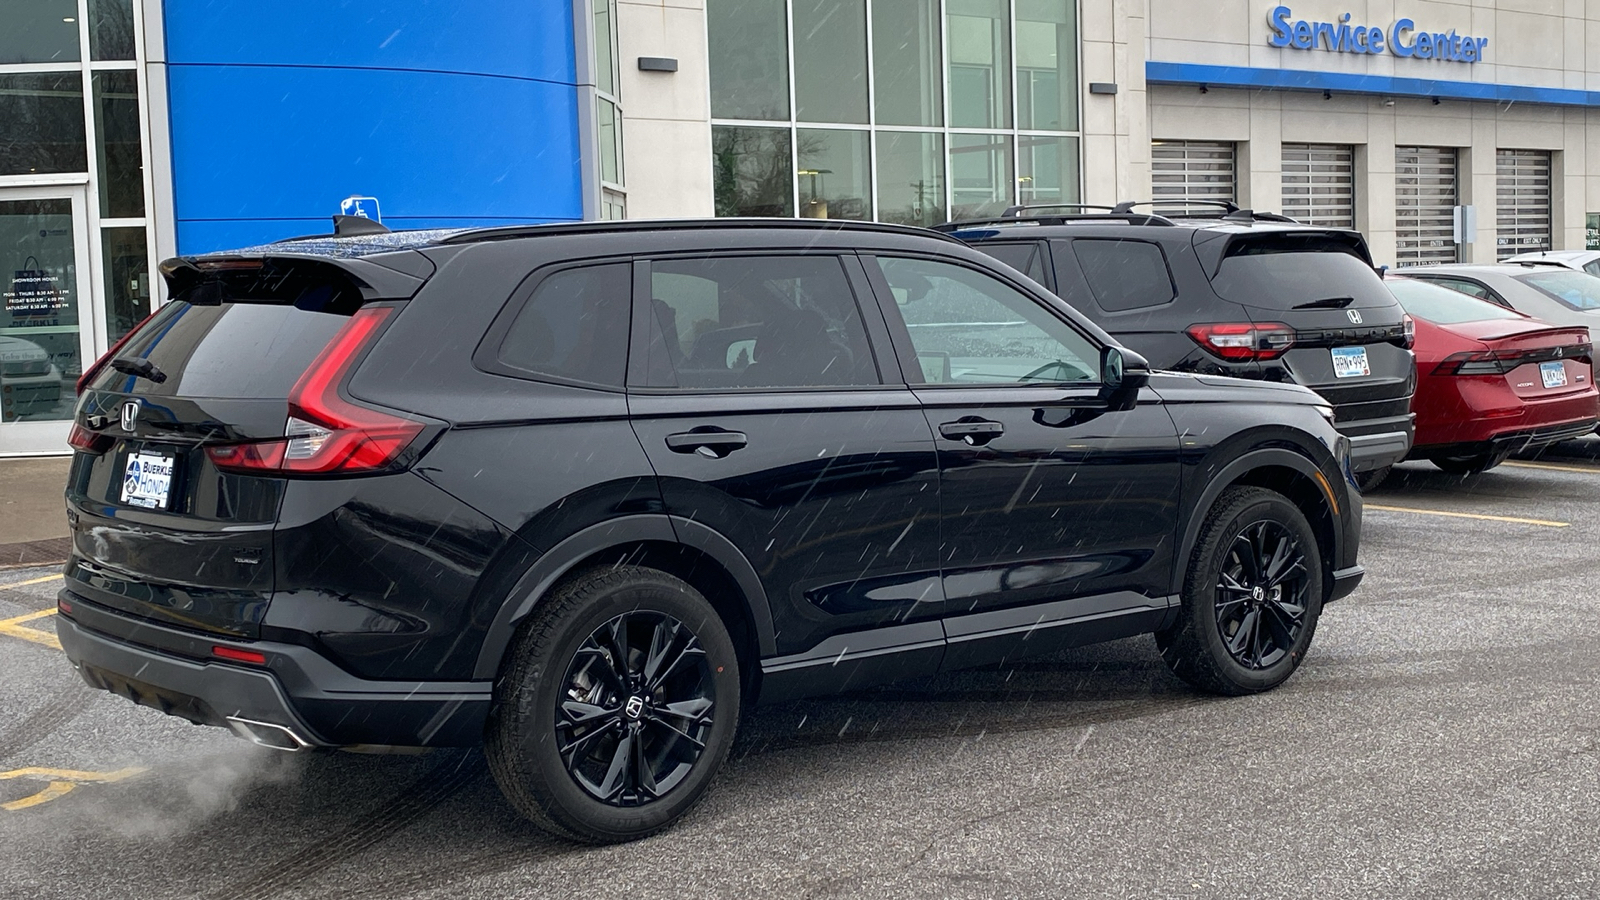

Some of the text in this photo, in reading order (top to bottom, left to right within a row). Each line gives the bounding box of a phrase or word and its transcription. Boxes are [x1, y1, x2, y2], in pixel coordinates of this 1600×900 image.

[1268, 6, 1489, 63] Service Center
[2, 352, 20, 361] Take
[22, 351, 35, 360] the
[142, 461, 173, 477] BUERKLE
[139, 473, 170, 496] HONDA
